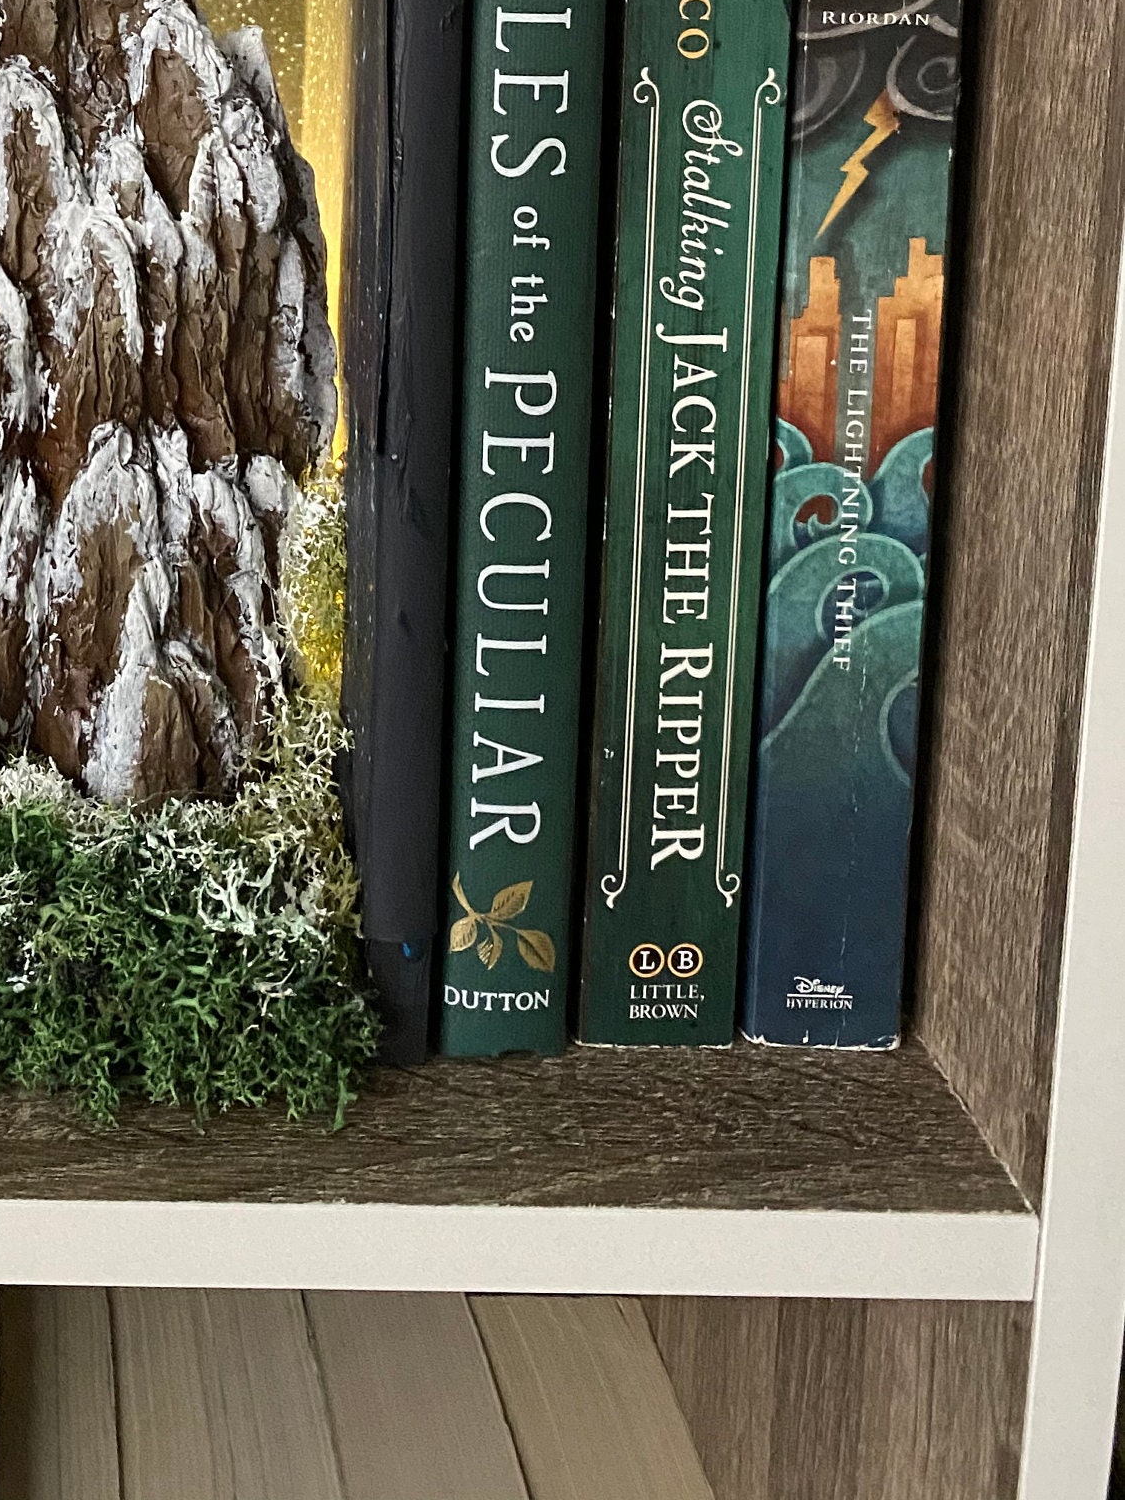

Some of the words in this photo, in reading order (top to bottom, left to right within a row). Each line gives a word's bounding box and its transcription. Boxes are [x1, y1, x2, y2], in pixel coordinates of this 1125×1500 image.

[822, 10, 931, 26] RIORDAN
[512, 206, 550, 251] of
[659, 100, 744, 312] Stalking
[509, 274, 549, 343] the
[849, 309, 873, 374] THE
[656, 323, 728, 475] JACK
[838, 389, 866, 566] LIGHTNING
[662, 493, 715, 625] THE
[469, 367, 557, 850] PECULIAR
[832, 578, 858, 672] THIEF
[650, 642, 714, 871] RIPPER
[444, 985, 550, 1012] DUTTON
[629, 1003, 698, 1019] BROWN
[630, 984, 705, 1001] LITTLE,
[786, 998, 853, 1010] HYPERION
